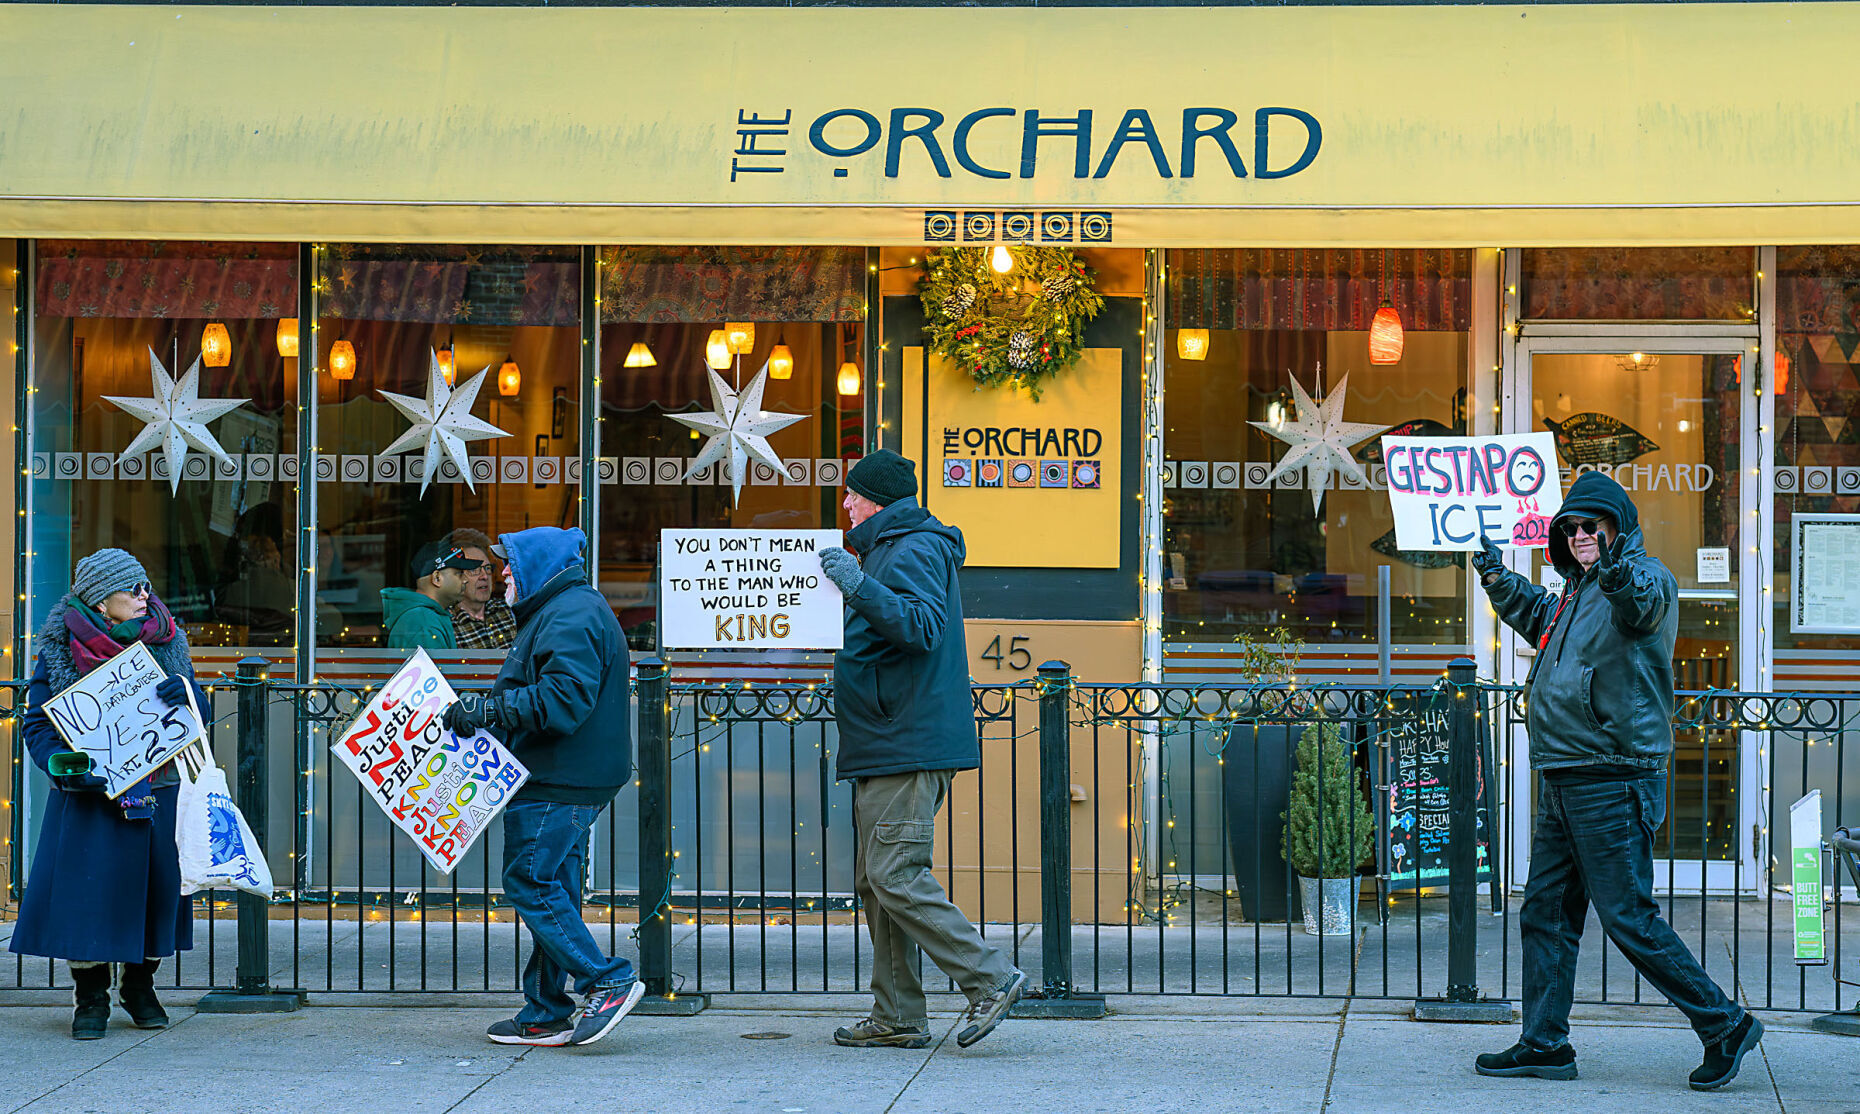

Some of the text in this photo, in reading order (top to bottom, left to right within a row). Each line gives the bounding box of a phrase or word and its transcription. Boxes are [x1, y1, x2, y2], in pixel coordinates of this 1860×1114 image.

[730, 107, 1323, 182] THE ORCHARD
[943, 427, 1102, 457] THE ORCHARD
[1385, 443, 1545, 498] GESTAPO
[1428, 503, 1510, 546] ICE
[674, 536, 815, 554] YOU DON'T MEAN
[669, 575, 818, 591] TO THE MAN WHO
[704, 558, 782, 573] A THING
[701, 593, 801, 610] WOULD BE
[715, 613, 791, 642] KING
[110, 650, 146, 684] ICE
[981, 634, 1031, 671] 45
[50, 690, 103, 743] NO
[103, 691, 128, 712] DATA
[345, 666, 422, 757] NO
[80, 698, 159, 765] YES
[140, 707, 190, 764] 25
[359, 676, 438, 773] Justice
[368, 696, 440, 787] NO
[411, 736, 491, 835] Justice
[422, 748, 501, 850] KNOW
[436, 762, 521, 866] PEACE
[1420, 813, 1449, 827] SPECIAL
[1796, 882, 1818, 893] BUTT
[1797, 894, 1819, 905] FREE
[1797, 906, 1819, 918] ZONE
